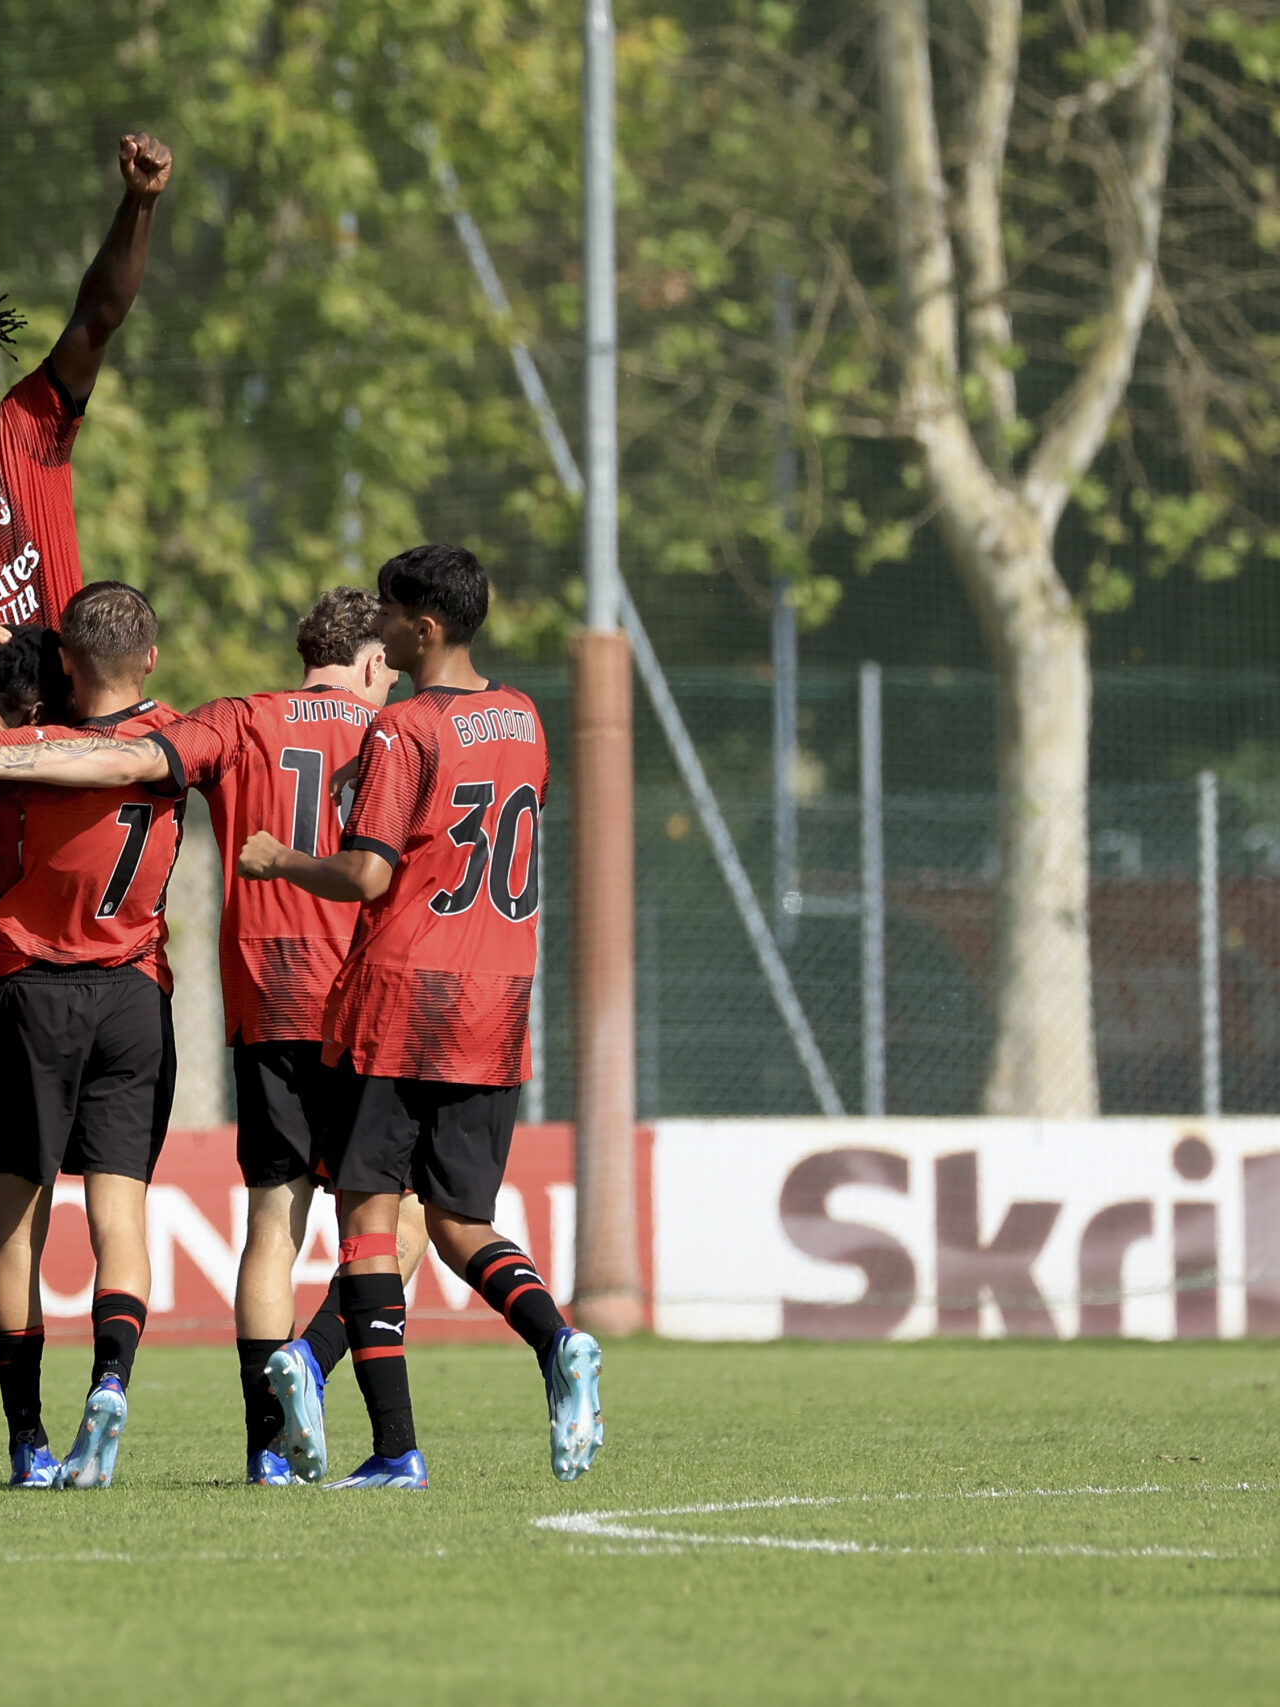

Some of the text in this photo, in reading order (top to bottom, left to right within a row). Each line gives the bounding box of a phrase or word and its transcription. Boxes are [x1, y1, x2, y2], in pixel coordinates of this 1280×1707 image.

[284, 698, 379, 728] JIMEN
[451, 707, 536, 748] BONOMI
[279, 746, 357, 859] 1
[428, 782, 540, 923] 30
[93, 801, 186, 920] 7
